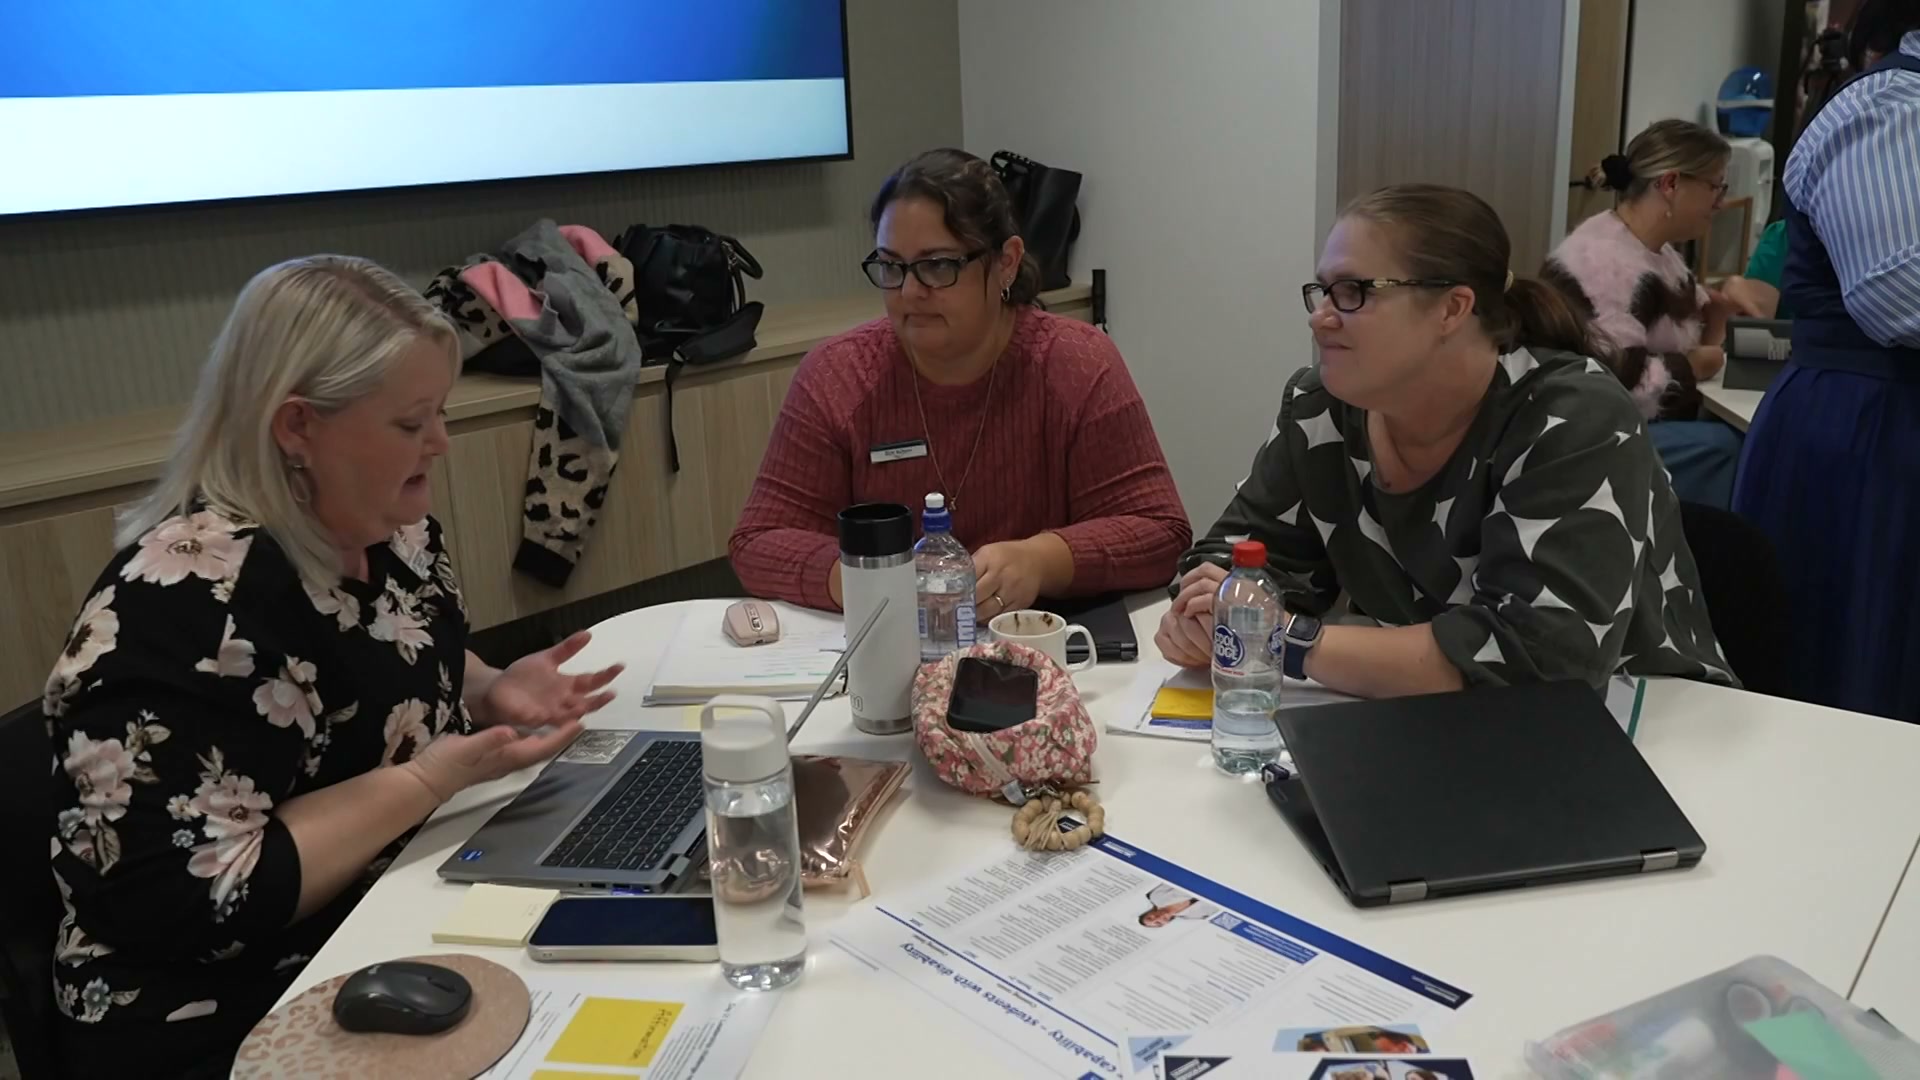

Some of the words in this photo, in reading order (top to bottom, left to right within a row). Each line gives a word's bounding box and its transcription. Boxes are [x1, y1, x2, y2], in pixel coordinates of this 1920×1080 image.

[901, 942, 953, 976] disability
[953, 974, 982, 994] with
[983, 991, 1040, 1027] students
[1048, 1029, 1118, 1073] capability
